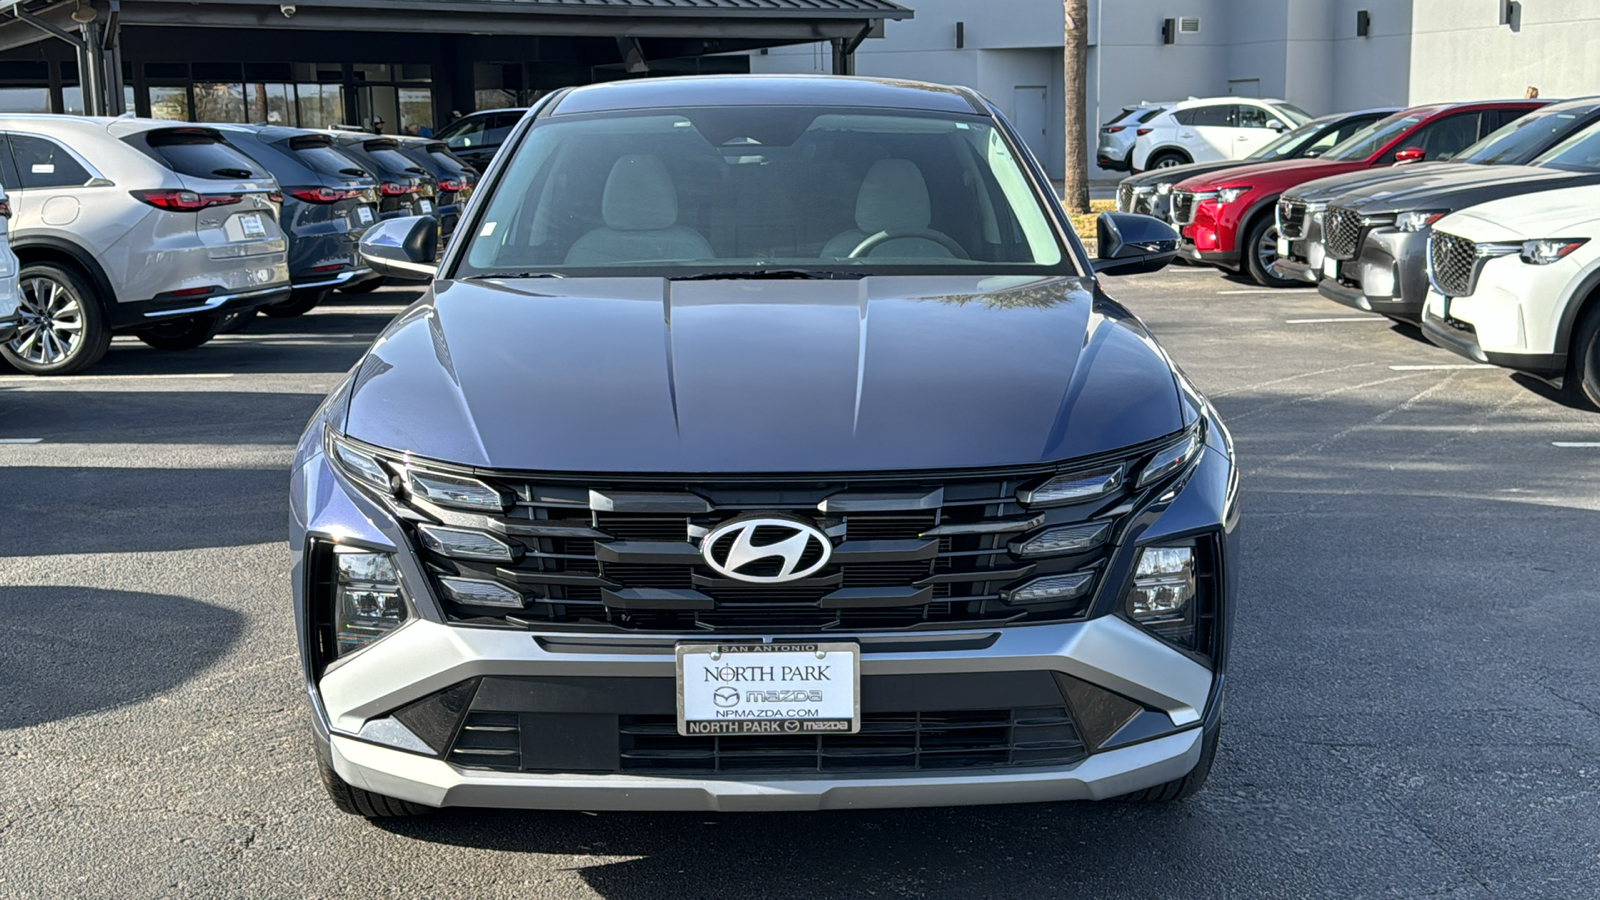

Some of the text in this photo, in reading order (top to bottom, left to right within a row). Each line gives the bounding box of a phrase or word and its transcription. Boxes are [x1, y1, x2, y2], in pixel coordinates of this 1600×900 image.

[704, 665, 831, 682] NORTH PARK
[746, 690, 823, 702] mazda
[716, 709, 819, 718] NPMAZDA.COM
[689, 721, 848, 733] NORTH PARK mazda
